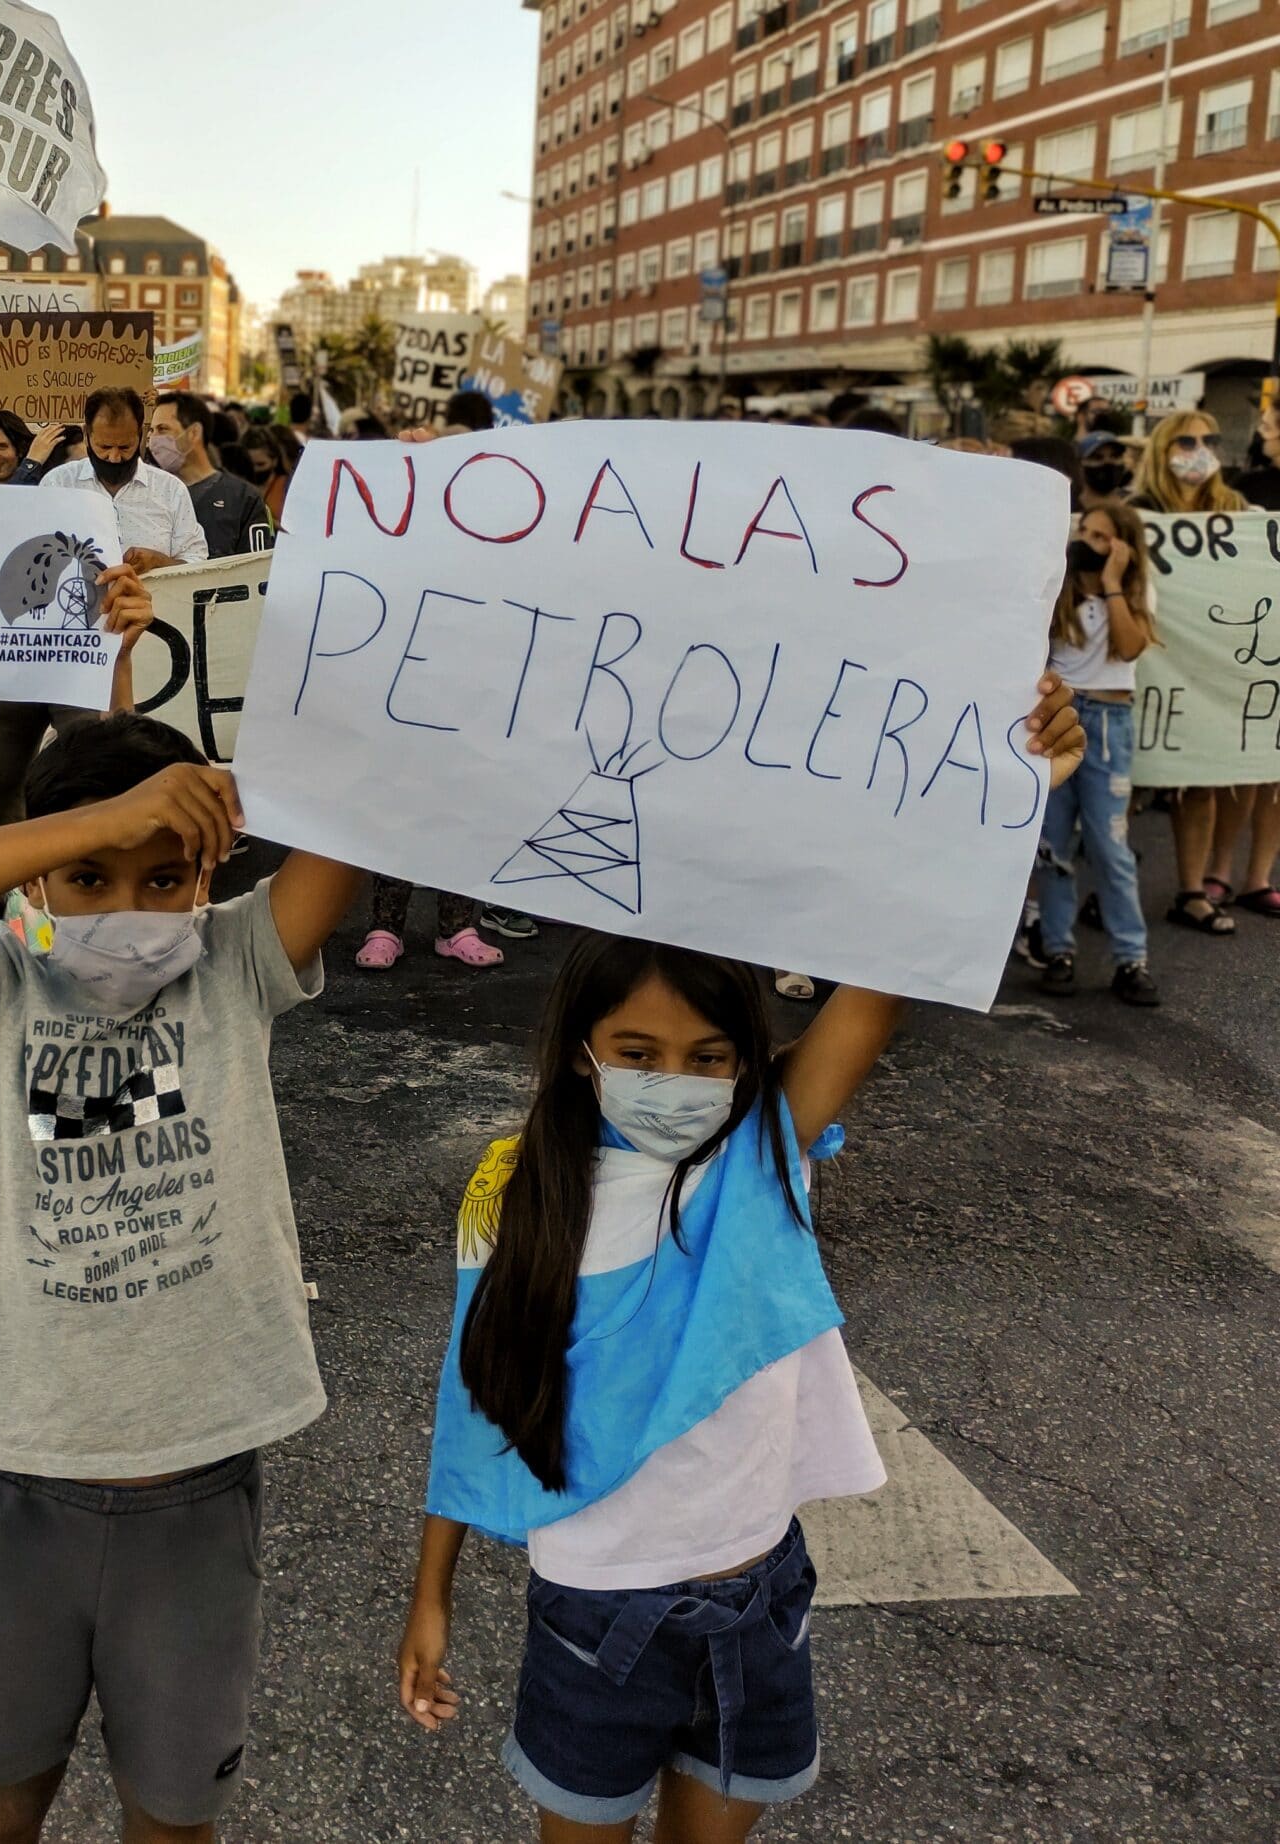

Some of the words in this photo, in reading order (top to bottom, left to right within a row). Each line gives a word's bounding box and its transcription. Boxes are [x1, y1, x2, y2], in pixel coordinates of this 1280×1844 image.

[2, 293, 80, 313] VENAS
[38, 345, 50, 360] ES
[58, 339, 138, 364] PROGRESO
[398, 322, 468, 357] TODAS
[27, 374, 38, 387] ES
[43, 370, 96, 388] SAQUEO
[13, 391, 87, 419] CONTAMi
[0, 633, 101, 648] #ATLANTICAZO
[295, 570, 1040, 829] PETROLERAS
[1139, 686, 1185, 751] DE
[33, 1020, 76, 1040] RIDE
[36, 1137, 125, 1184] STOM
[134, 1117, 211, 1169] CARS
[81, 1171, 185, 1217] Angeles
[190, 1168, 215, 1189] 94
[58, 1224, 109, 1245] ROAD
[115, 1209, 183, 1236] POWER
[84, 1255, 119, 1284] BORN
[122, 1245, 135, 1267] TO
[140, 1232, 168, 1258] RIDE
[43, 1278, 118, 1304] LEGEND
[125, 1279, 149, 1299] OF
[156, 1253, 214, 1292] ROADS
